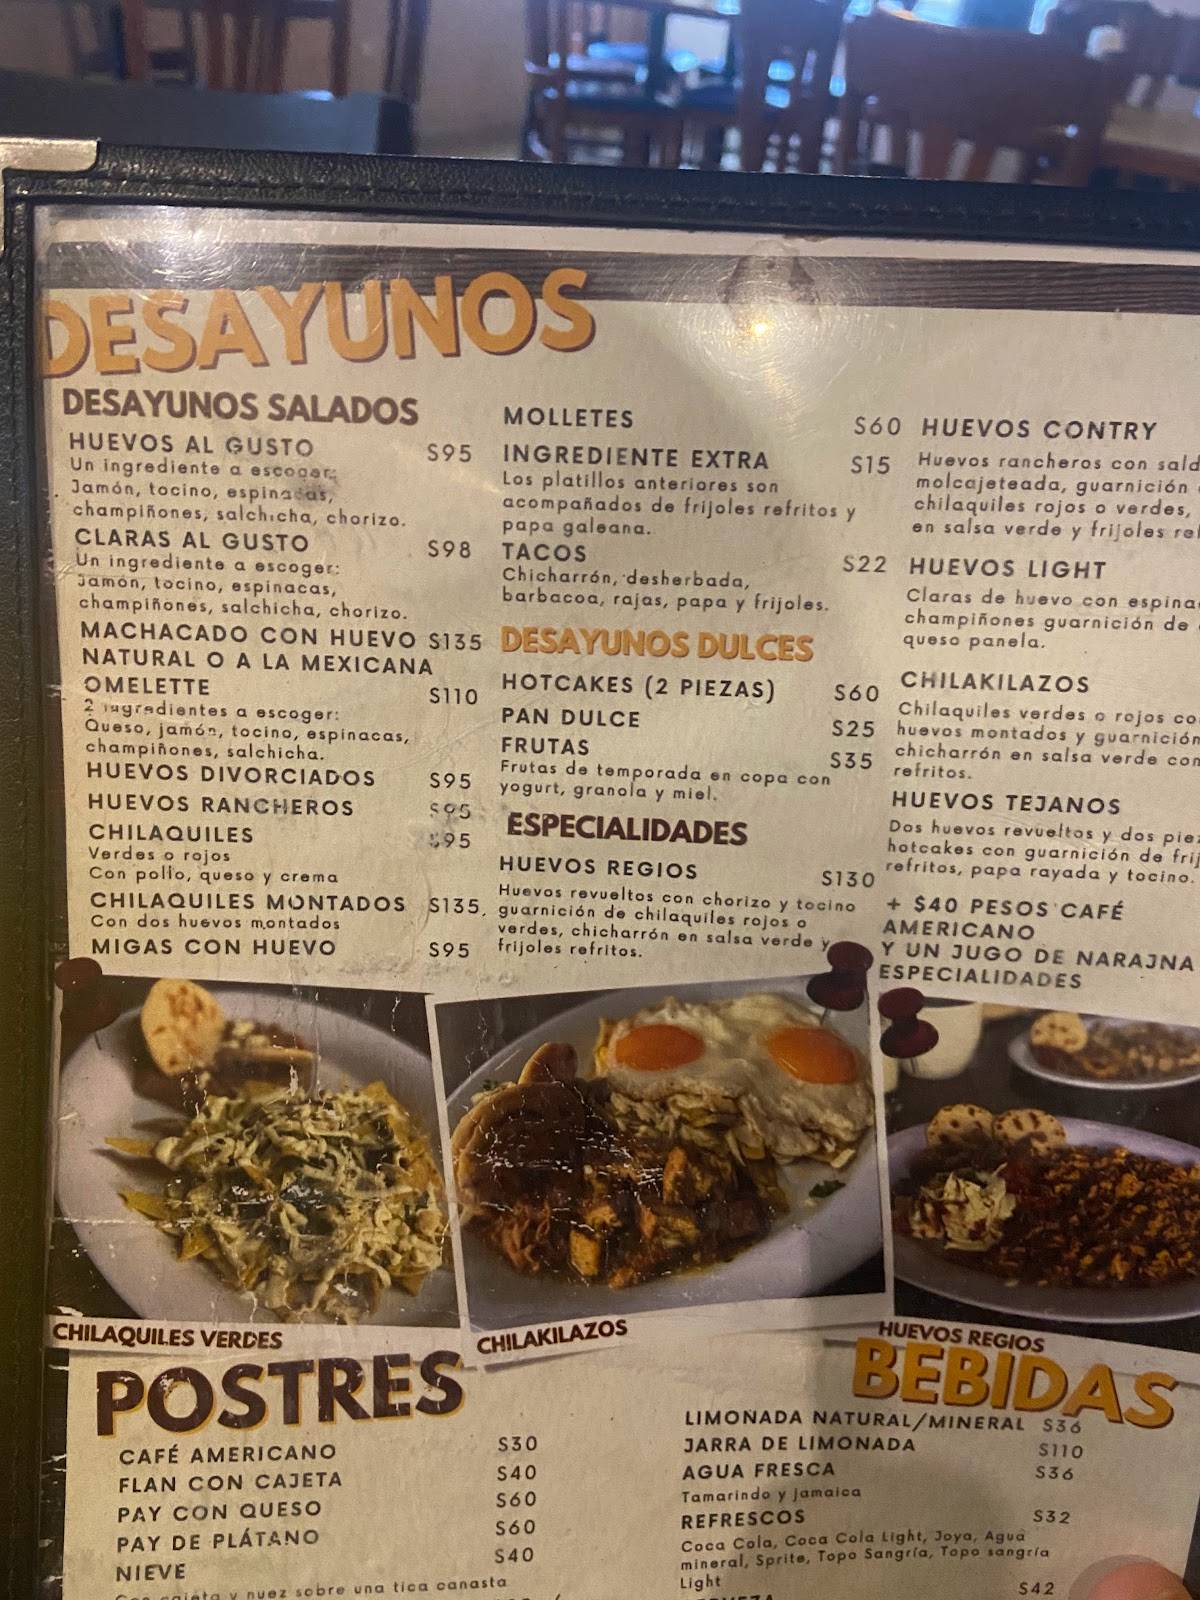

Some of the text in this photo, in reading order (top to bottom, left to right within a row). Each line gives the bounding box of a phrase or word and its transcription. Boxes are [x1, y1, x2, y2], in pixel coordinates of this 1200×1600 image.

[42, 267, 597, 378] DESAYUNOS
[63, 388, 419, 426] DESAYUNOS SALADOS
[504, 406, 633, 428] MOLLETES
[922, 418, 1157, 440] HUEVOS CONTRY
[70, 432, 313, 457] HUEVOS AL GUSTO
[504, 444, 769, 469] INGREDIENTE EXTRA
[503, 470, 778, 493] Los platillos anteriores son
[502, 495, 855, 522] acompañados de frijoles refritos y
[914, 493, 1190, 518] chilaquiles rojos o verdes,
[503, 516, 651, 538] papa galeana.
[75, 528, 308, 553] CLARAS AL GUSTO
[502, 542, 586, 562] TACOS
[503, 565, 749, 590] Chicharrón, desherbada,
[909, 557, 1106, 579] HUEVOS LIGHT
[78, 573, 336, 598] Jamón, tocino, espinacas,
[79, 593, 407, 619] champiñones, salchicha, chorizo.
[503, 585, 828, 615] barbacoa, rajas, papa y frijoles.
[81, 621, 416, 648] MACHACADO CON HUEVO
[502, 626, 814, 662] DESAYUNOS DULCES
[903, 632, 1045, 651] queso panela.
[83, 648, 433, 675] NATURAL O A LA MEXICANA
[84, 676, 210, 696] OMELETTE
[502, 673, 774, 704] HOTCAKES (2 PIEZAS)
[901, 671, 1089, 693] CHILAKILAZOS
[502, 707, 640, 728] PAN DULCE
[86, 737, 324, 760] champiñones, salchicha.
[502, 737, 589, 756] FRUTAS
[87, 761, 374, 786] HUEVOS DIVORCIADOS
[894, 762, 972, 779] refritos.
[88, 793, 353, 816] HUEVOS RANCHEROS
[892, 790, 1120, 815] HUEVOS TEJANOS
[89, 824, 253, 843] CHILAQUILES
[507, 812, 748, 846] ESPECIALIDADES
[500, 856, 697, 880] HUEVOS REGIOS
[886, 857, 1194, 884] refritos, papa rayada y tocino.
[90, 892, 407, 912] CHILAQUILES MONTADOS
[499, 884, 855, 913] Huevos revueltos con chorizo y tocino
[914, 895, 958, 913] $40
[970, 899, 1048, 917] PESOS
[1060, 901, 1123, 920] CAFÉ
[499, 904, 806, 931] guarnición de chilaquiles rojos o
[882, 919, 1035, 940] AMERICANO
[92, 938, 335, 956] MIGAS CON HUEVO
[498, 938, 642, 959] frijoles refritos.
[881, 941, 1194, 972] Y UN JUGO DE NARAJNA
[880, 965, 1081, 989] ESPECIALIDADES
[54, 1324, 283, 1350] CHILAQUILES VERDES
[477, 1320, 628, 1354] CHILAKILAZOS
[878, 1321, 1045, 1352] HUEVOS REGIOS
[96, 1351, 465, 1438] POSTRES
[853, 1337, 1178, 1430] BEBIDAS
[685, 1409, 1024, 1432] LIMONADA NATURAL/MINERAL
[119, 1444, 336, 1466] CAFÉ AMERICANO
[684, 1436, 915, 1453] JARRA DE LIMONADA
[119, 1472, 342, 1493] FLAN CON CAJETA
[682, 1462, 835, 1480] AGUA FRESCA
[682, 1487, 861, 1503] Tamarindo y jamaica
[118, 1501, 321, 1523] PAY CON QUESO
[681, 1509, 805, 1529] REFRESCOS
[117, 1527, 319, 1553] PAY DE PLÁTANO
[681, 1529, 1024, 1552] Coca Cola, Coca Cola Light, Joya, Agua
[116, 1563, 186, 1582] NIEVE
[681, 1574, 720, 1592] Light
